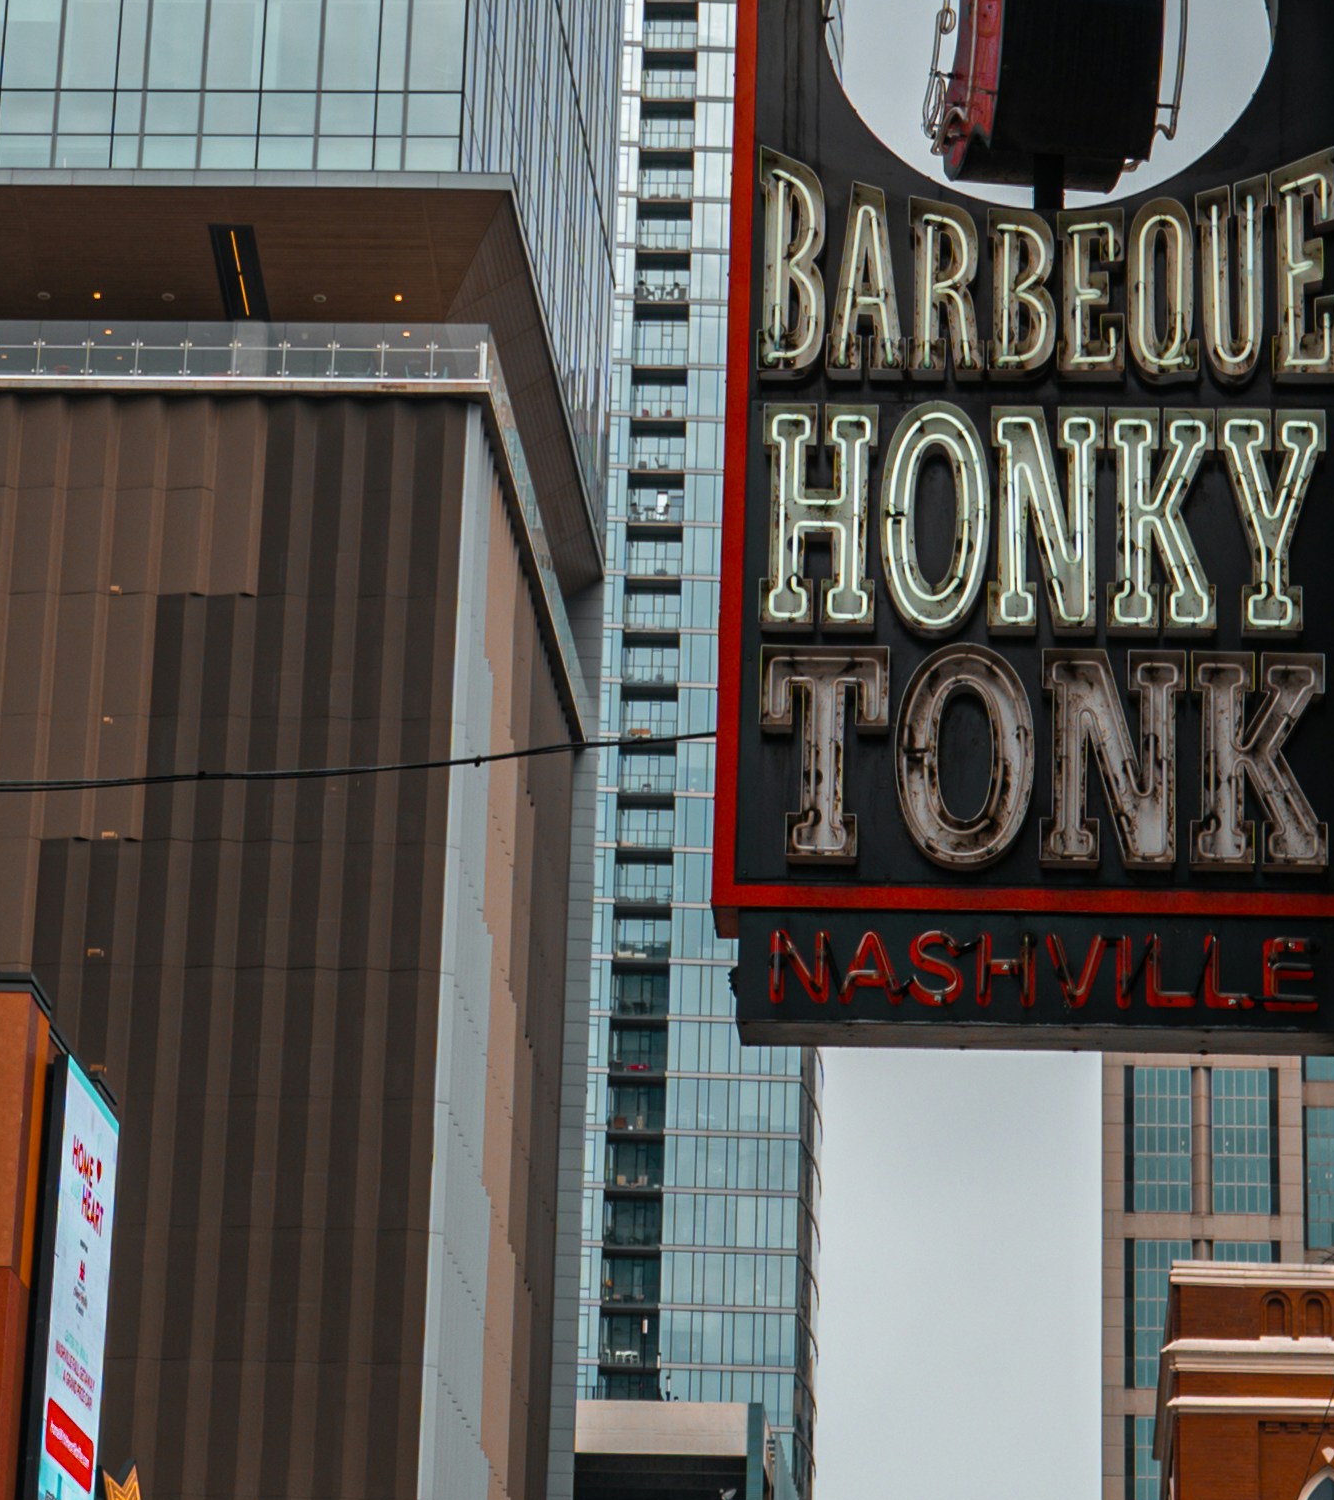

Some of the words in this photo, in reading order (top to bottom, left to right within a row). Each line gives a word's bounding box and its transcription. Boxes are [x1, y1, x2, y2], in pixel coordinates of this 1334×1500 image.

[760, 402, 1326, 638] HONKY
[760, 643, 1329, 872] TONK
[770, 929, 1319, 1012] NASHVILLE
[72, 1134, 94, 1188] HOME
[81, 1183, 104, 1237] HEART
